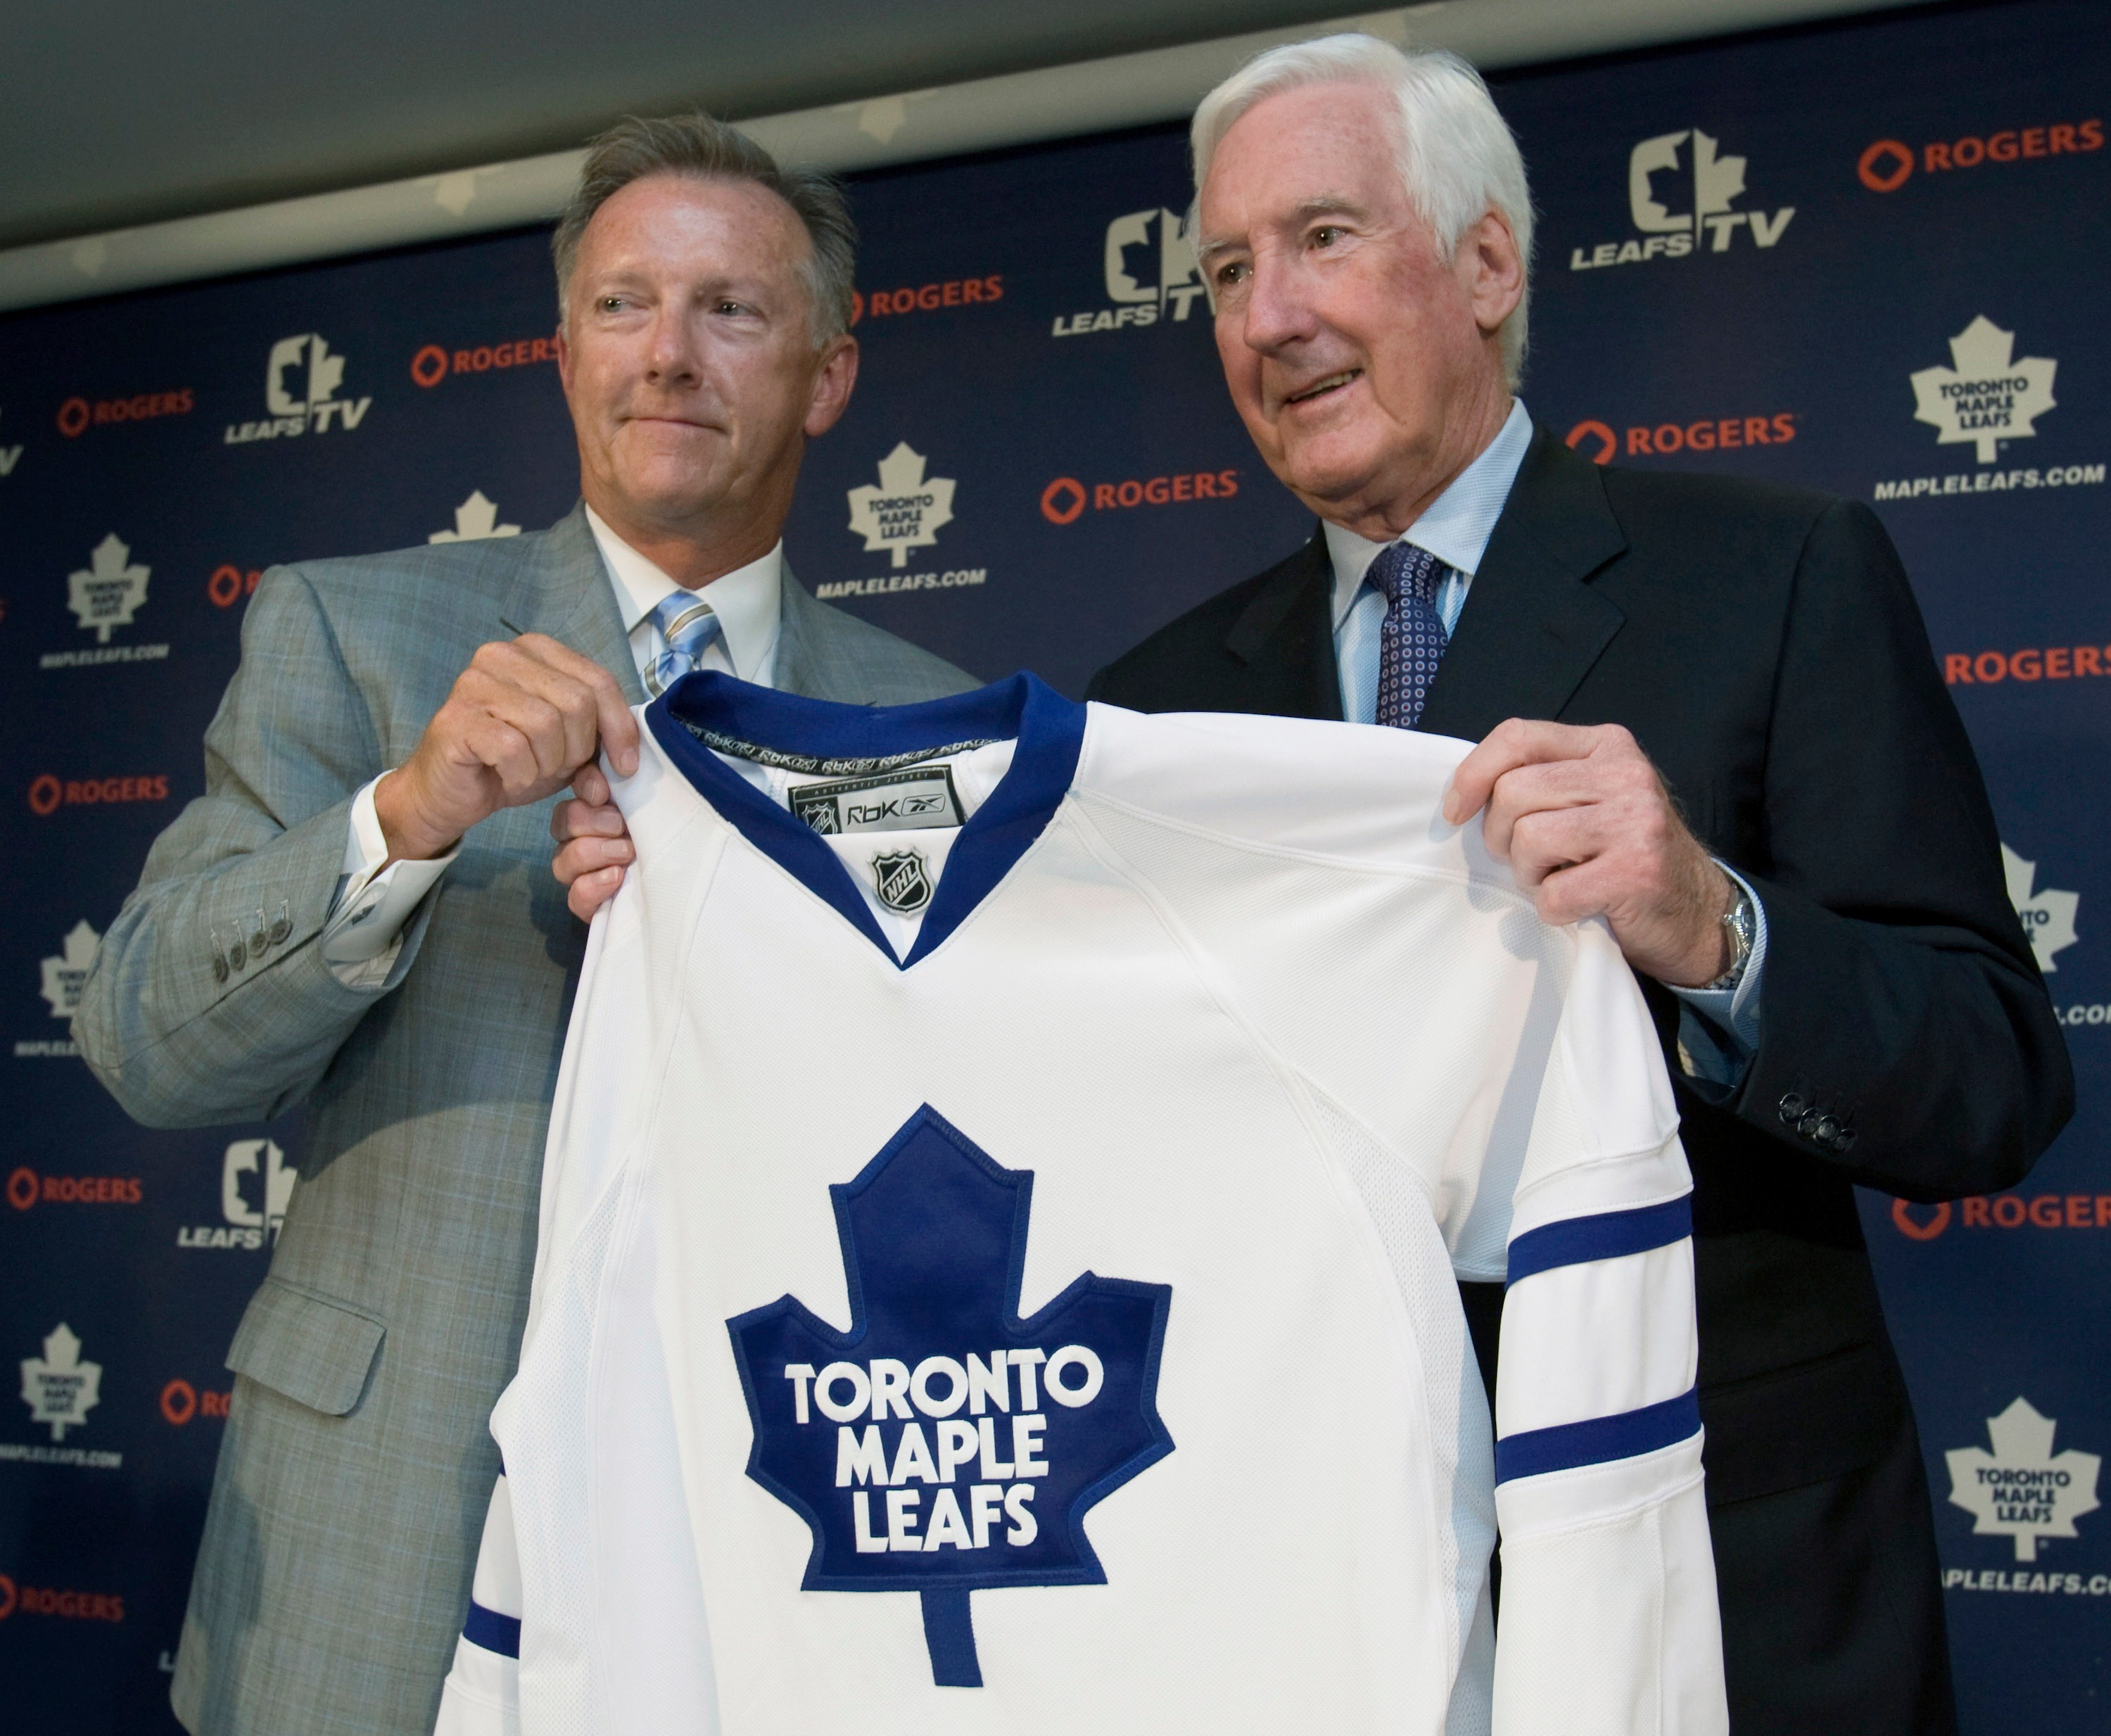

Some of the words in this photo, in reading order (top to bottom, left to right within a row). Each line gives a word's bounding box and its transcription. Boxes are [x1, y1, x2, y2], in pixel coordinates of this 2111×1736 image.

[1924, 120, 2104, 172] ROGERS
[1570, 232, 1693, 271] LEAFS
[1704, 207, 1796, 253] TV
[871, 274, 1003, 317] ROGERS
[1052, 303, 1159, 338] LEAFS
[1939, 377, 2028, 398] TORONTO
[94, 389, 195, 424] ROGERS
[224, 417, 305, 444] LEAFS
[314, 397, 372, 433] TV
[1955, 395, 2013, 414] MAPLE
[1627, 412, 1796, 456] ROGERS
[1960, 412, 2010, 430] LEAFS
[1095, 469, 1238, 509] ROGERS
[1874, 463, 2106, 500] MAPLELEAFS.COM
[869, 495, 934, 512] TORONTO
[879, 509, 922, 525] MAPLE
[882, 524, 919, 539] LEAFS
[816, 569, 987, 598] MAPLELEAFS.COM
[1946, 646, 2111, 685] ROGER
[65, 775, 169, 804] ROGERS
[847, 799, 901, 826] RbK
[885, 864, 918, 902] NHL
[42, 1177, 141, 1203] ROGERS
[177, 1226, 263, 1250] LEAFS
[785, 1345, 1104, 1424] TORONTO
[835, 1414, 1049, 1487] MAPLE
[1976, 1469, 2071, 1487] TORONTO
[1993, 1487, 2055, 1504] MAPLE
[853, 1483, 1038, 1553] LEAFS
[1997, 1505, 2052, 1523] LEAFS
[1941, 1568, 2111, 1596] PLELEAFS.C
[22, 1588, 124, 1623] ROGERS
